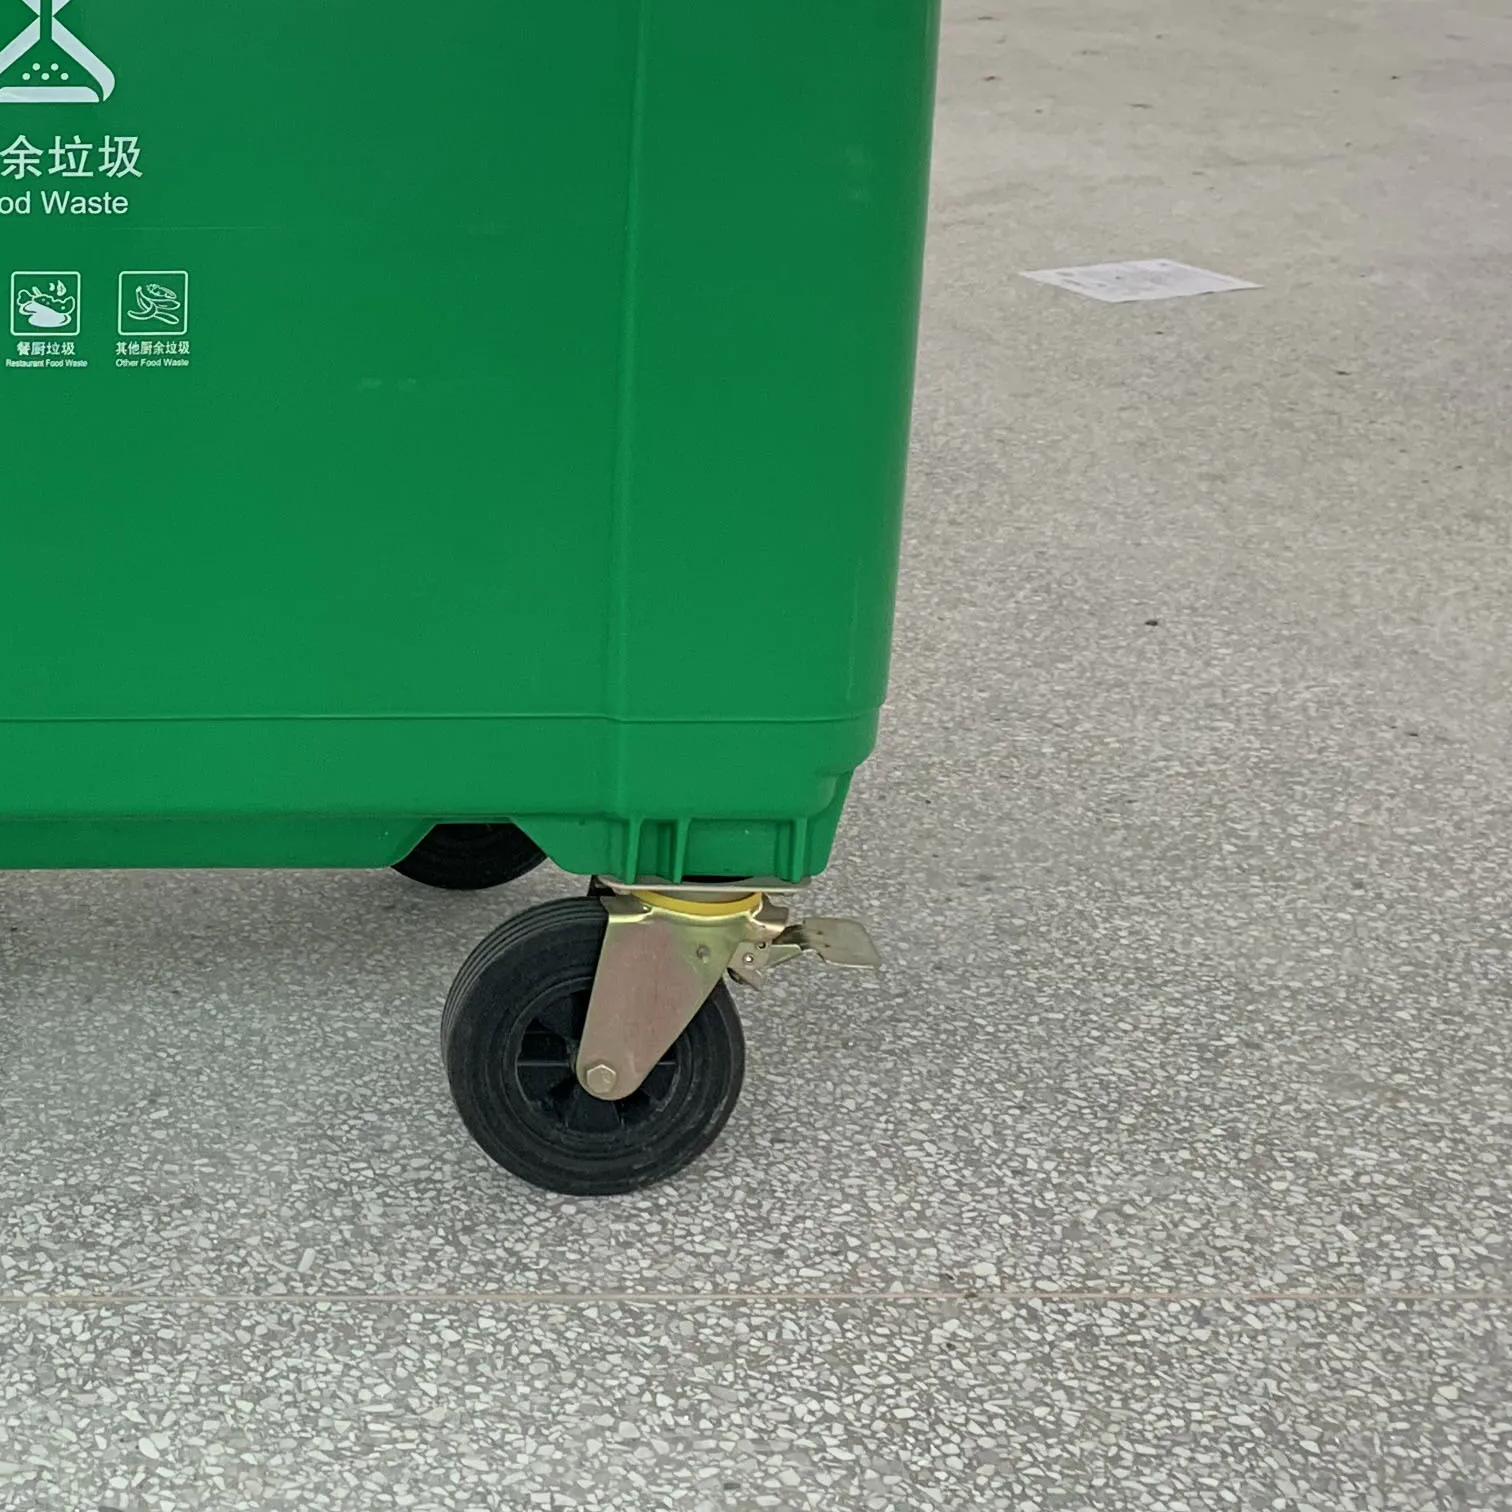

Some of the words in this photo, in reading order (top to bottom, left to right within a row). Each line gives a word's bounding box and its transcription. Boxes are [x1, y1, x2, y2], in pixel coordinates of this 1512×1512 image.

[40, 190, 129, 215] Waste
[16, 340, 76, 356] 餐厨垃圾
[115, 340, 190, 355] 其他厨余垃圾
[5, 358, 45, 367] Restaurant
[45, 358, 64, 367] Food
[64, 358, 89, 367] Waste
[115, 358, 139, 367] Other
[140, 358, 162, 367] Food
[162, 358, 190, 367] Waste
